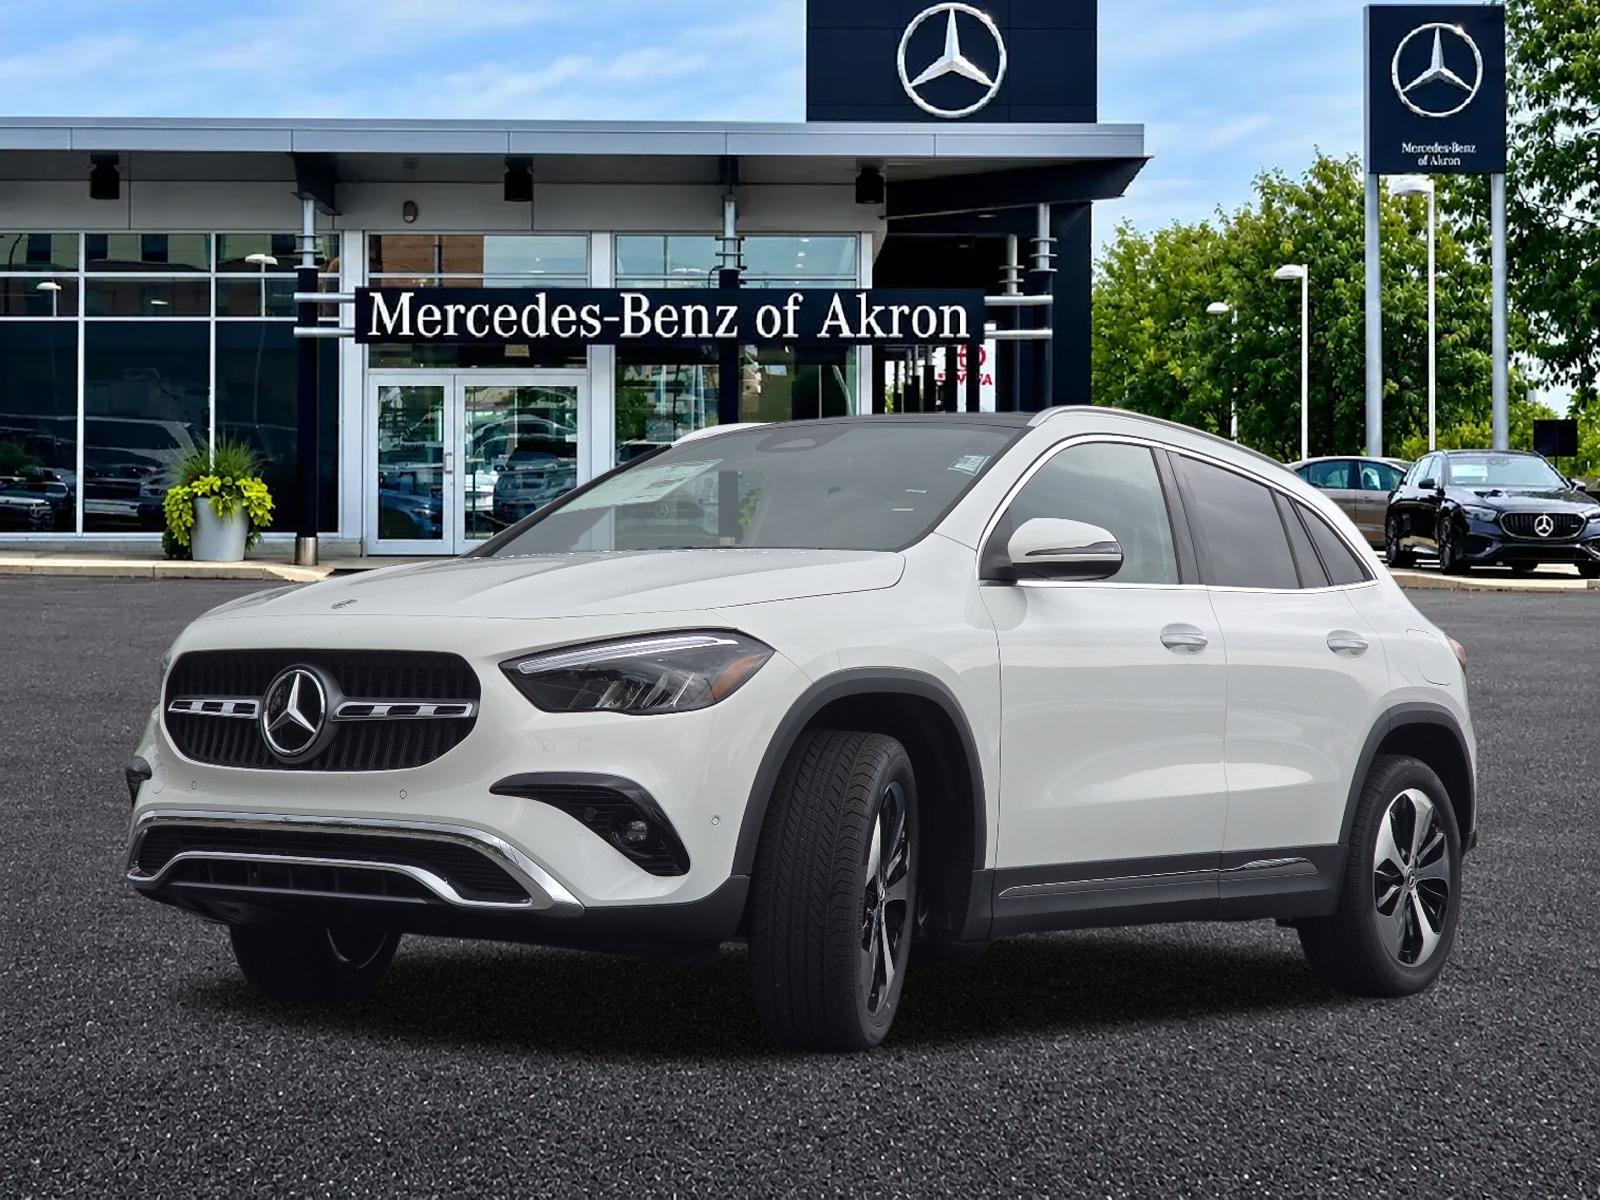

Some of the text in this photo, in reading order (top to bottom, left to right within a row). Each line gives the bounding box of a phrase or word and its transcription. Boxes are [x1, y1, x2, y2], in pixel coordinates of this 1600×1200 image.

[1401, 141, 1476, 153] Mercedes-Benz
[1417, 154, 1460, 165] of Akron
[367, 291, 970, 338] Mercedes-Benz of Akron
